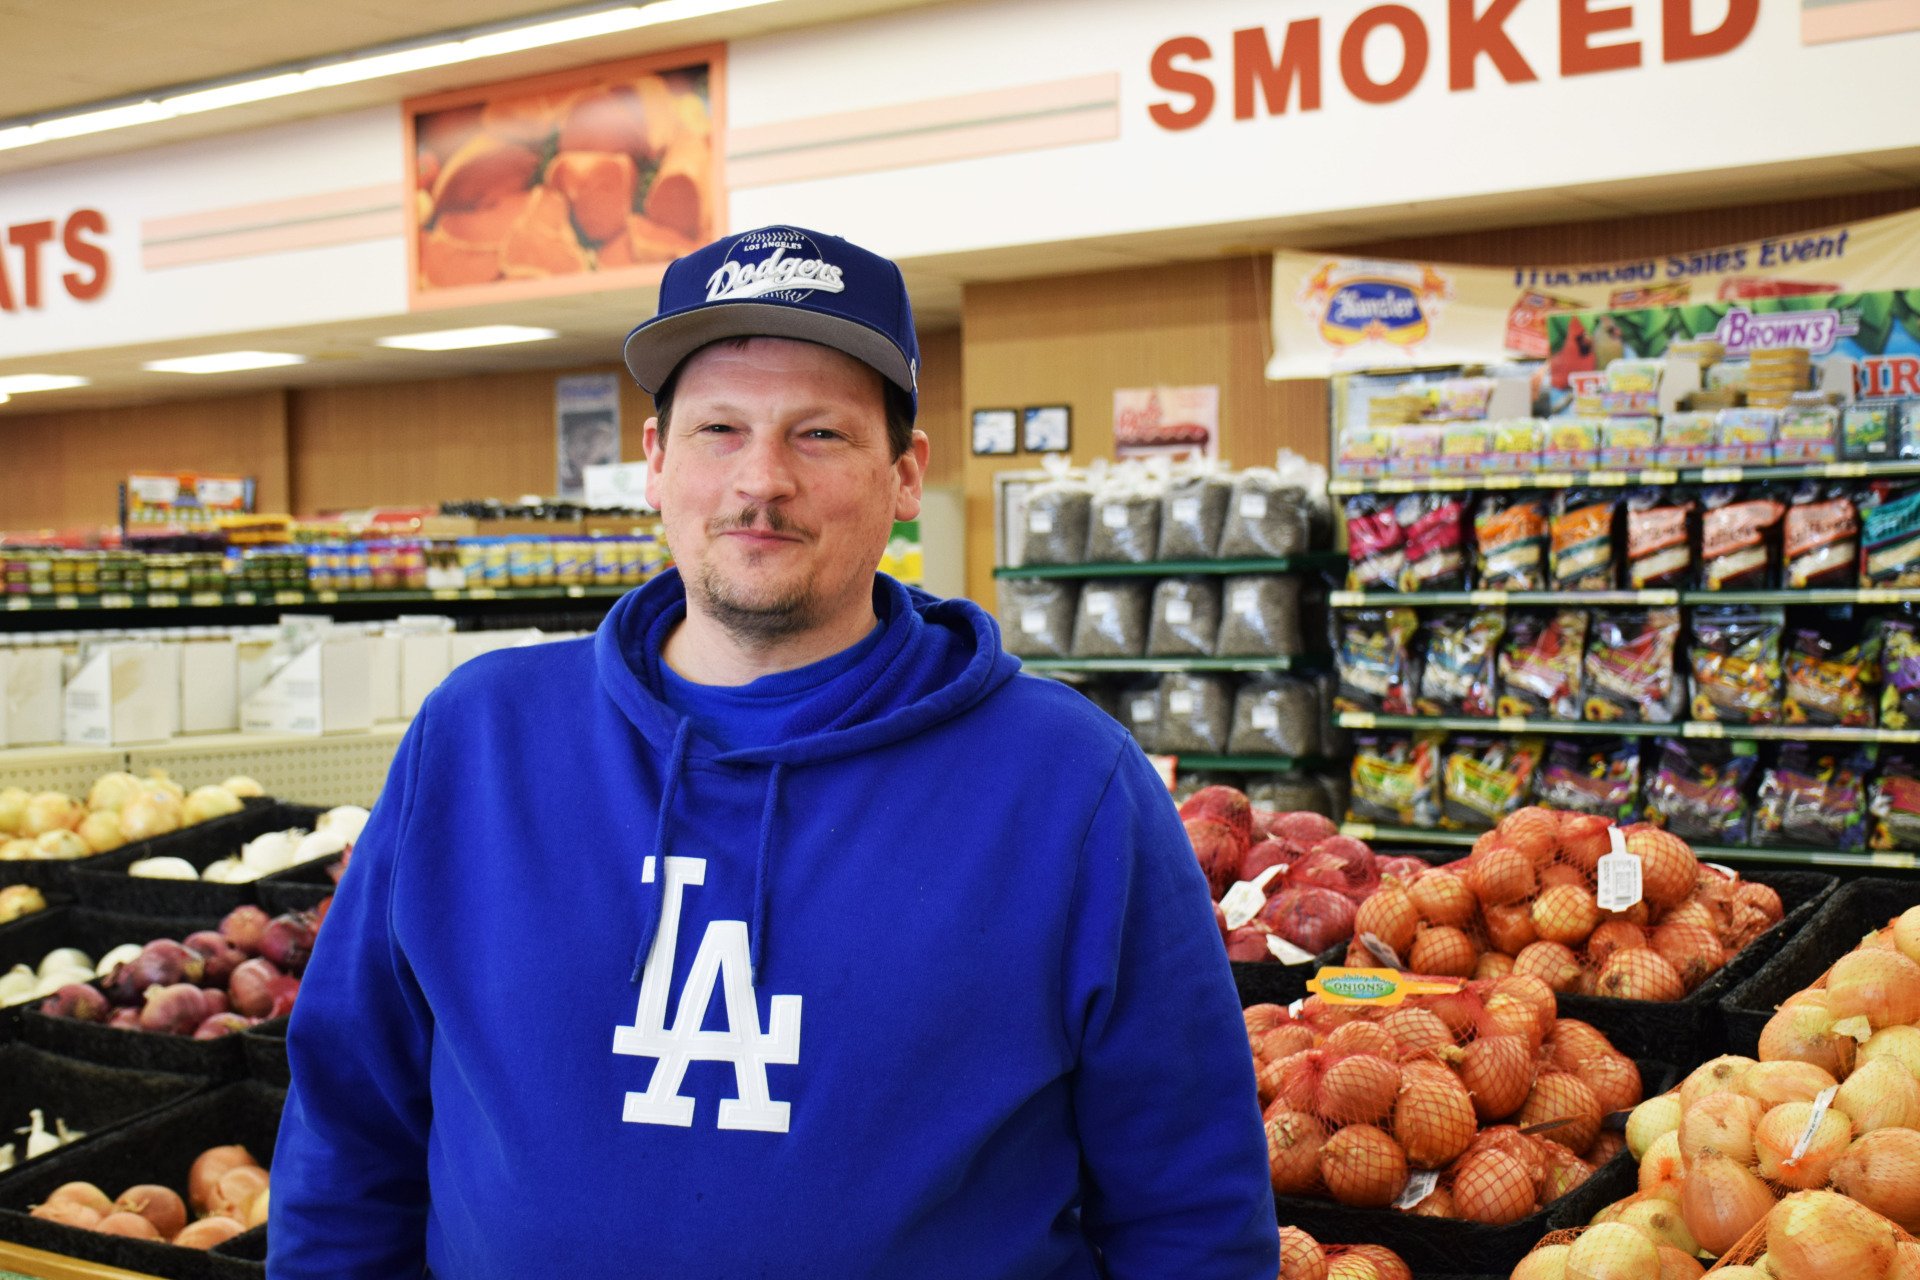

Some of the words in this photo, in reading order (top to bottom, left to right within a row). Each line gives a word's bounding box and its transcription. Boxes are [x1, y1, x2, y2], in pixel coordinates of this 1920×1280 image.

[1147, 0, 1761, 132] SMOKED
[743, 243, 760, 252] LOS
[762, 241, 802, 250] ANGELES
[1666, 249, 1747, 279] Sales
[1758, 230, 1849, 267] Event
[706, 247, 846, 302] Dodgers
[1852, 357, 1920, 397] IR
[612, 856, 803, 1133] LA
[1334, 982, 1384, 992] ONIONS
